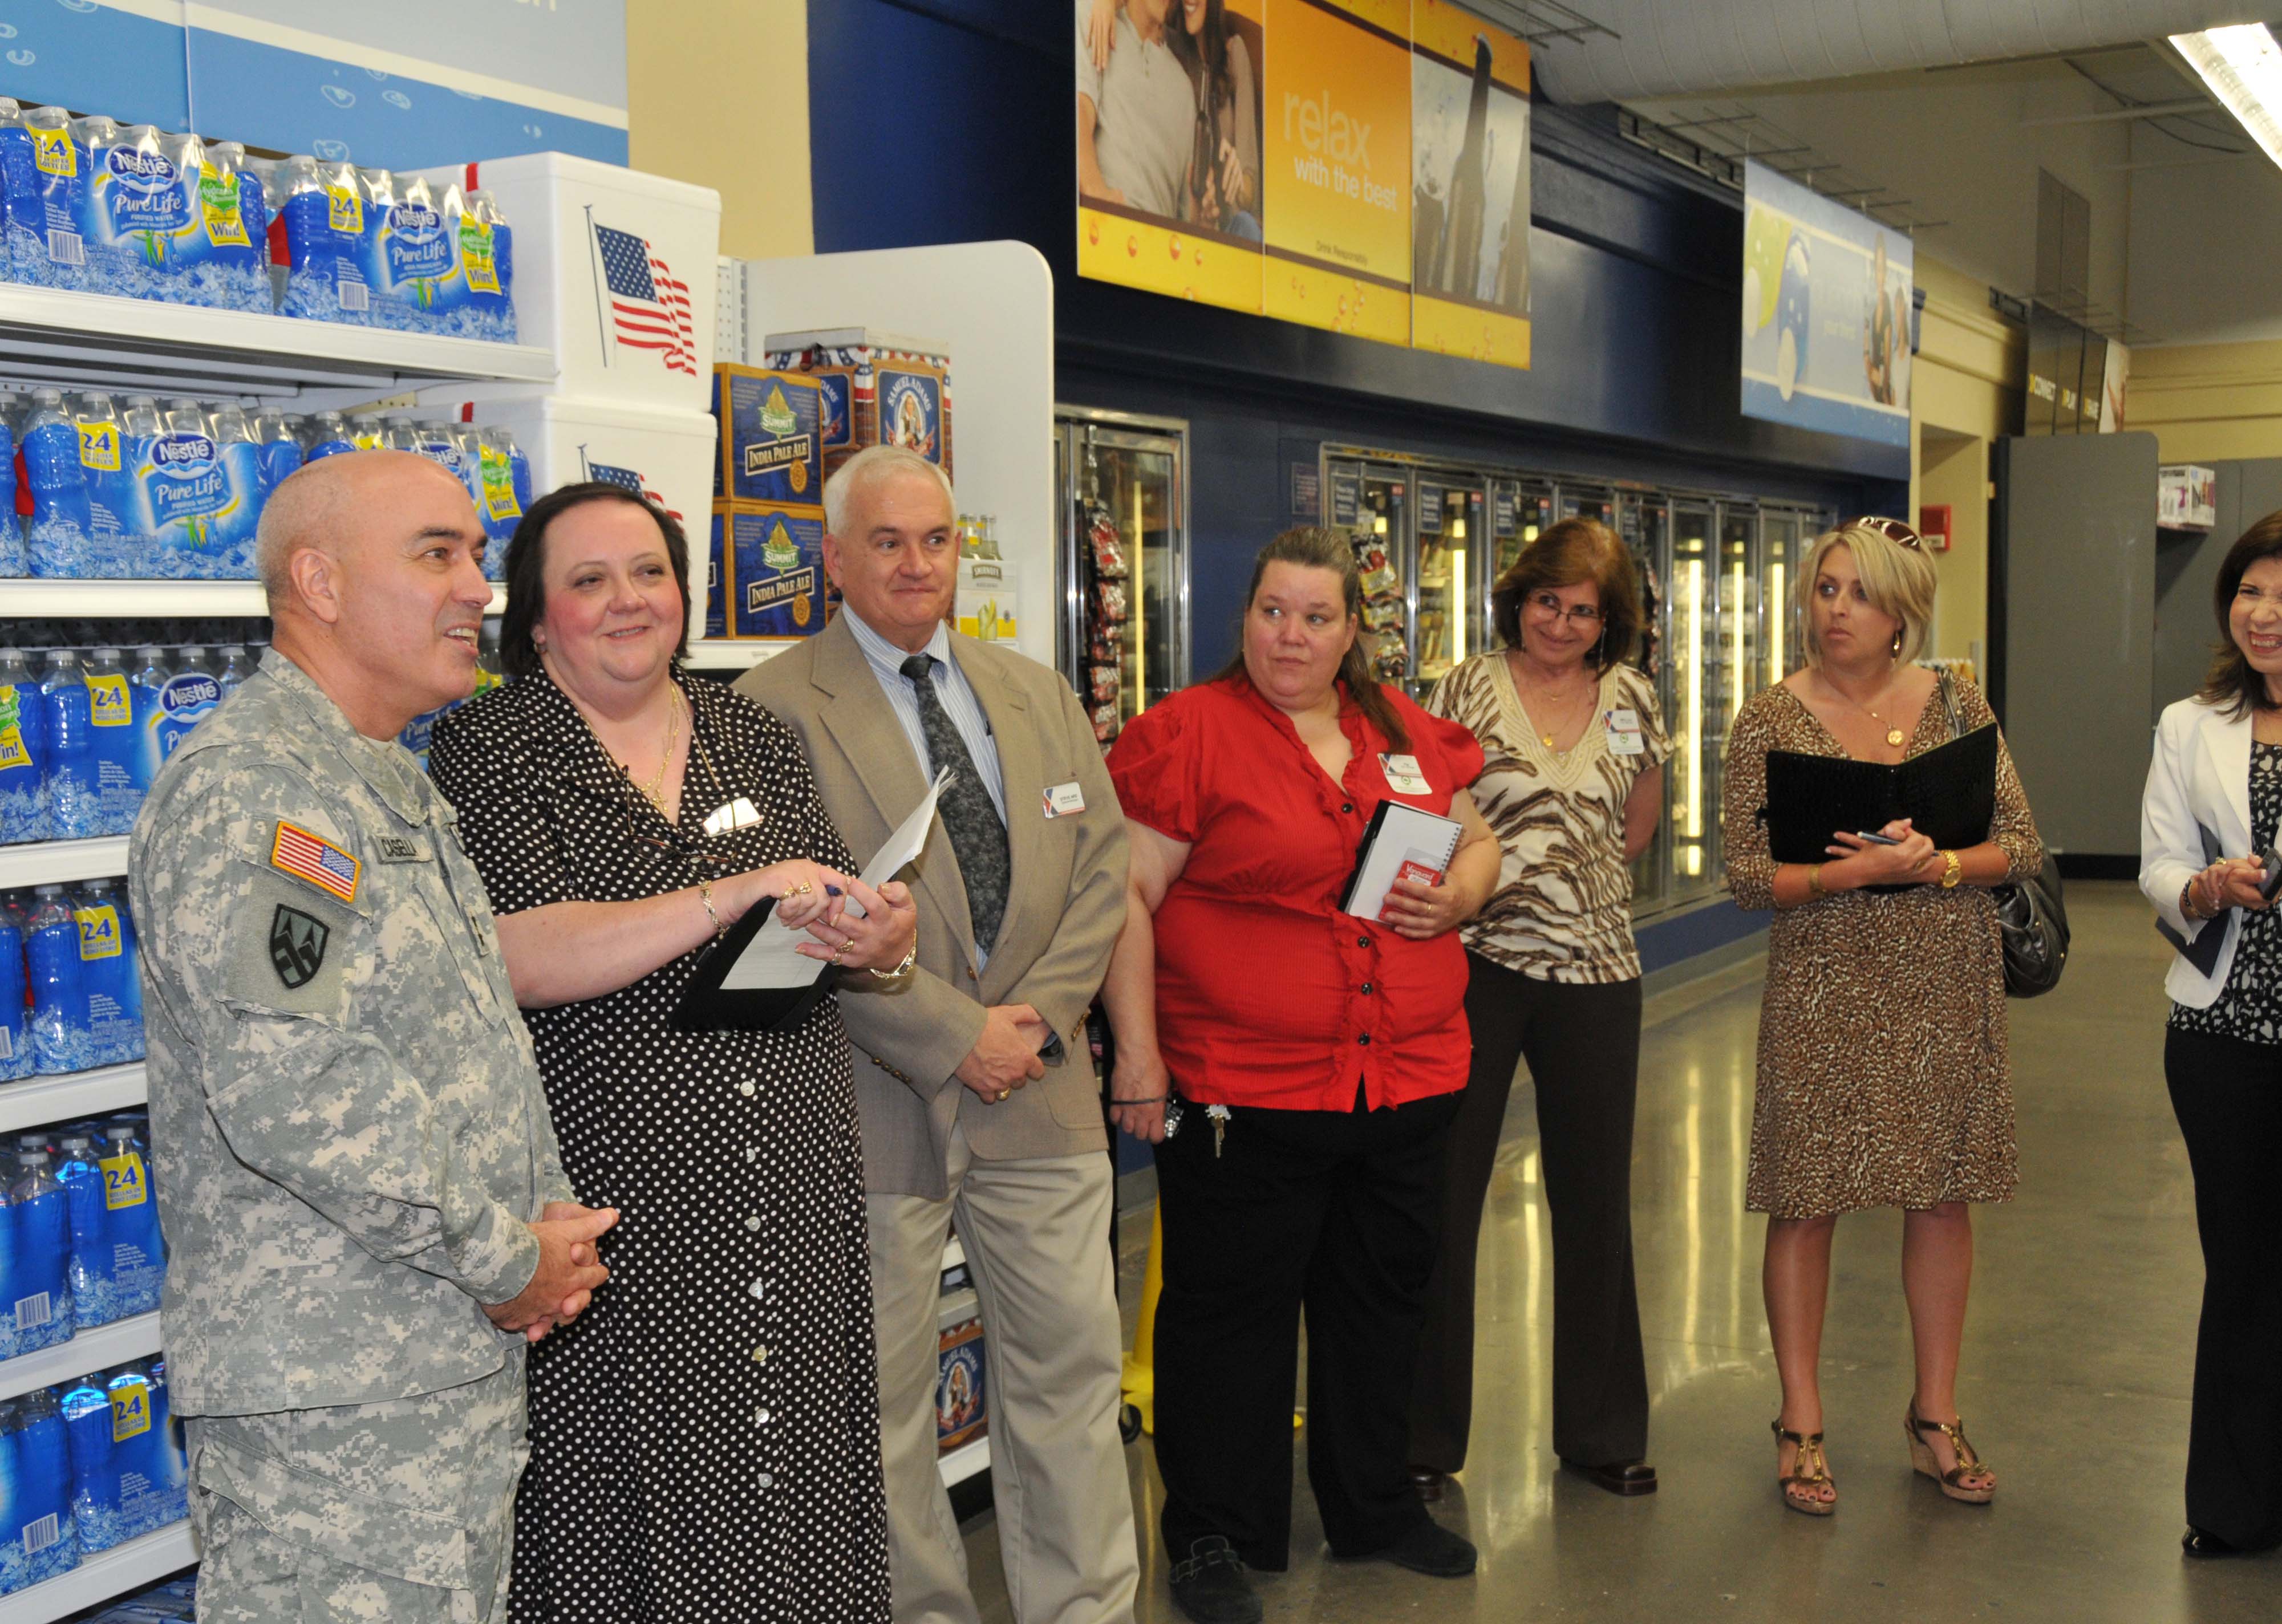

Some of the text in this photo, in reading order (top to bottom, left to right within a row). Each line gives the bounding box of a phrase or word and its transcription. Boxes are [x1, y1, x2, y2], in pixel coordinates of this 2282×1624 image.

[1284, 90, 1371, 170] relax
[35, 136, 67, 156] 24
[1294, 155, 1397, 212] with the best
[114, 193, 151, 214] Pure
[153, 192, 182, 213] Life
[333, 197, 356, 214] 24
[392, 247, 422, 266] Pure
[423, 240, 447, 261] Life
[821, 380, 840, 402] DAMS
[887, 376, 933, 412] SAMUEL ADAMS
[762, 415, 794, 428] SUMMIT
[83, 433, 112, 451] 24
[159, 440, 209, 461] Nestlé
[749, 442, 808, 468] INDIA PALE ALE
[155, 474, 222, 505] Pure Life
[765, 550, 796, 563] SUMMIT
[752, 575, 810, 605] INDIA PALE ALE
[92, 687, 123, 707] 24
[169, 681, 217, 707] Nestlé
[0, 741, 19, 760] in!
[1406, 863, 1436, 880] Vanguard
[82, 919, 112, 940] 24
[107, 1166, 139, 1189] 24
[115, 1395, 143, 1422] 24
